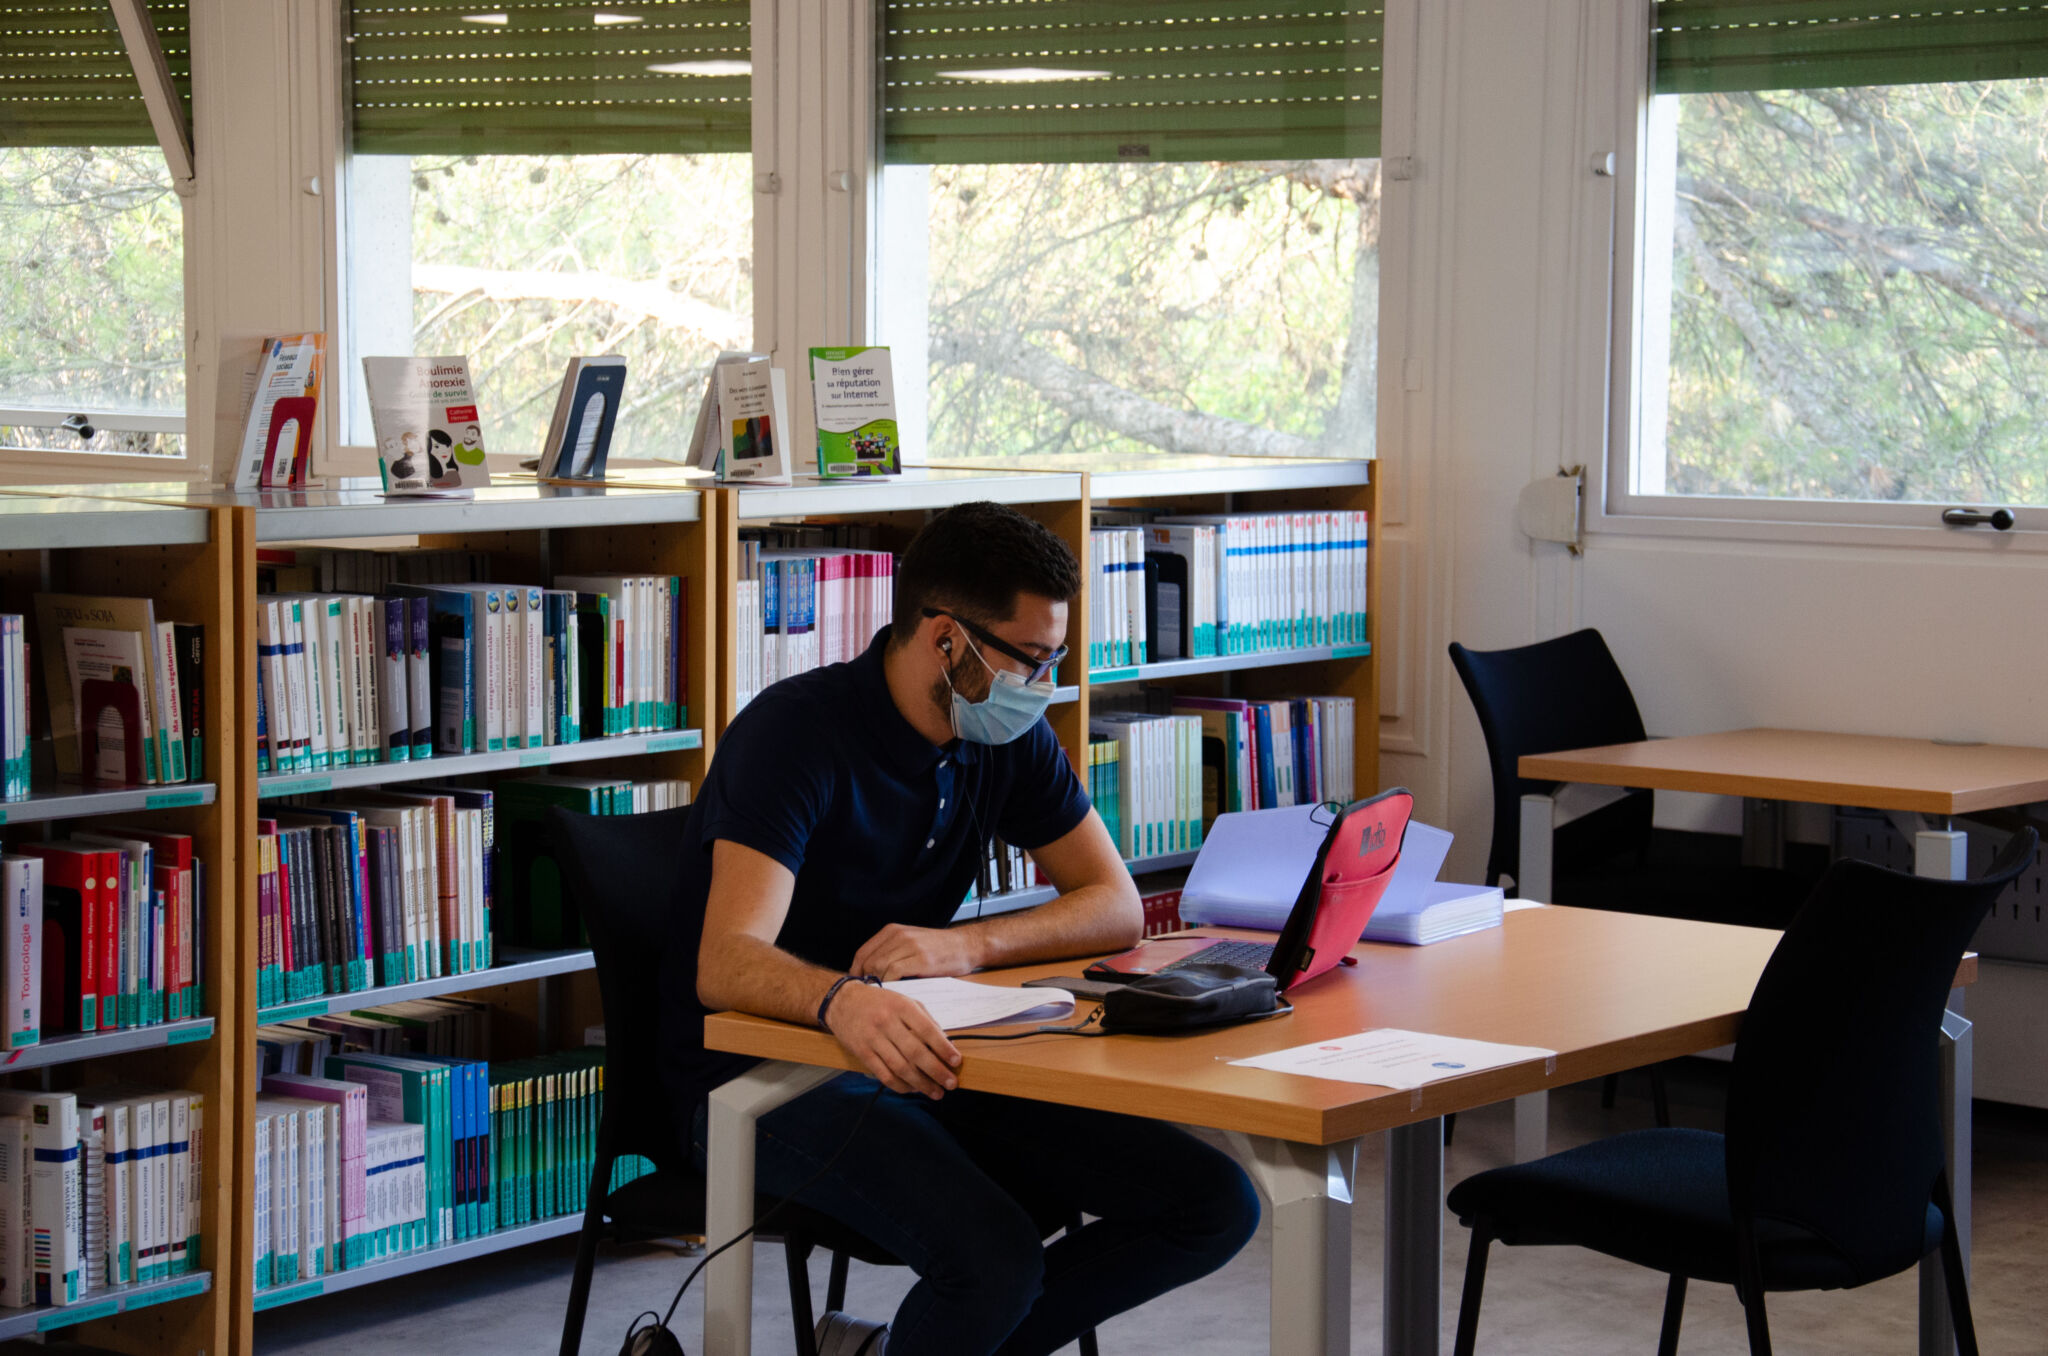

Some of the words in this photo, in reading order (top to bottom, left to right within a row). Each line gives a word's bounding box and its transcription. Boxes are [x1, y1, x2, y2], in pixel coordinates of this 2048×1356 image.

[417, 365, 463, 376] Boulimie
[852, 367, 874, 377] gérer
[419, 378, 465, 388] Anorexie
[836, 378, 880, 389] réputation
[165, 632, 176, 686] végétarienne
[170, 688, 179, 718] cuisine
[172, 720, 179, 732] Ma
[21, 924, 31, 1000] Toxicologie
